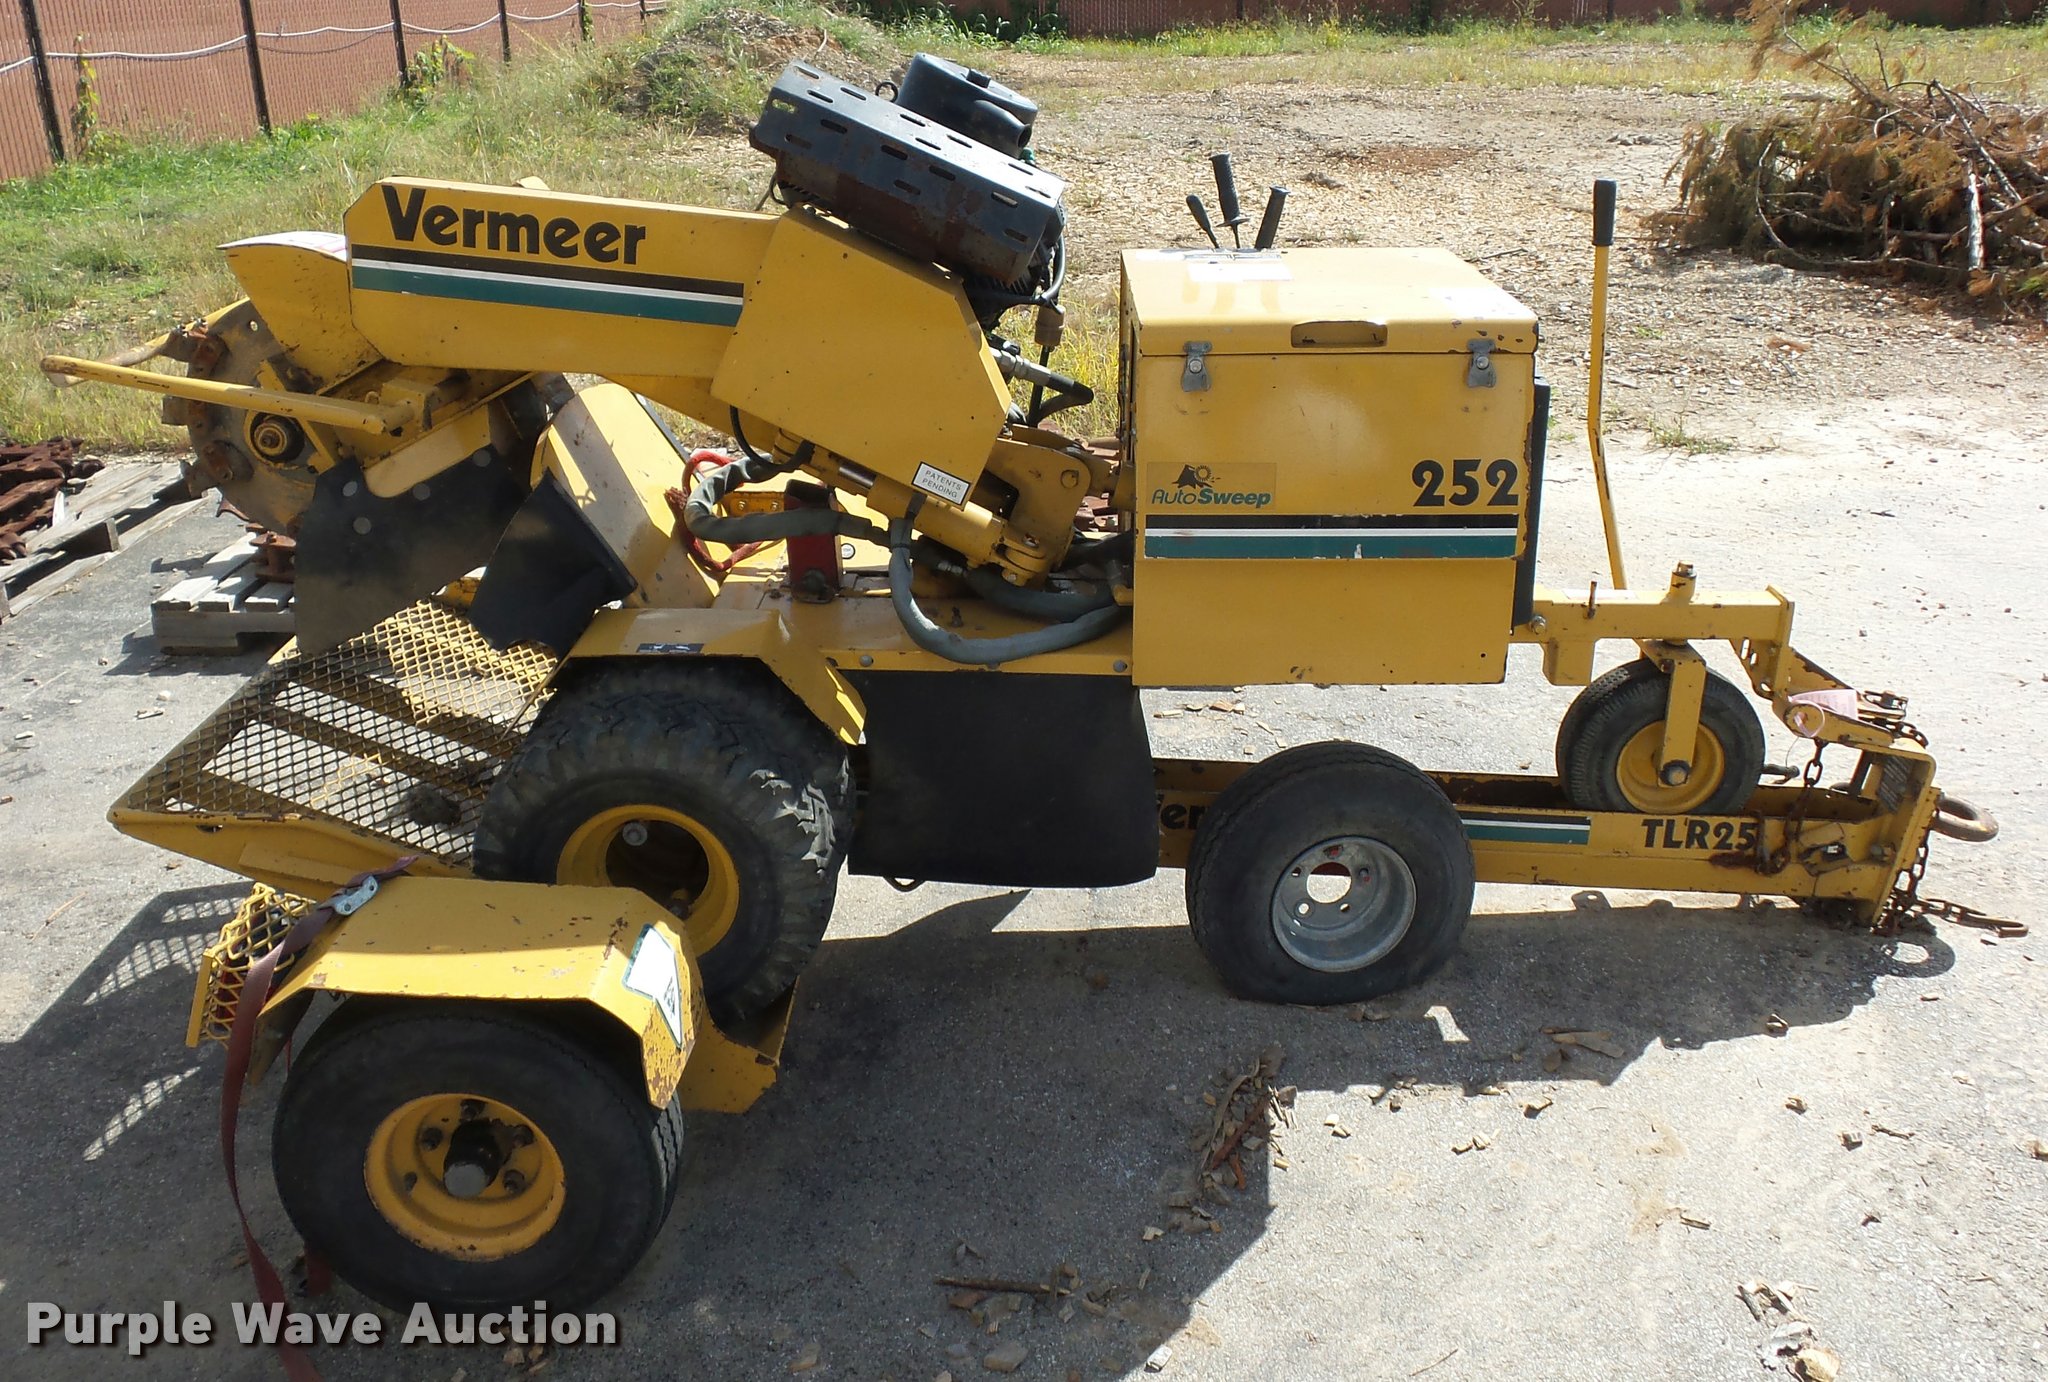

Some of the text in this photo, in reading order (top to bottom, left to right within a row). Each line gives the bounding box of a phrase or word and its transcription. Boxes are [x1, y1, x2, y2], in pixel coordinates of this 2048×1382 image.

[381, 184, 646, 265] Vermeer
[922, 478, 958, 498] PENDING
[925, 470, 962, 491] PATENTS
[1411, 458, 1519, 507] 252
[1151, 488, 1272, 508] AutoSweep
[1641, 818, 1759, 851] TLR25
